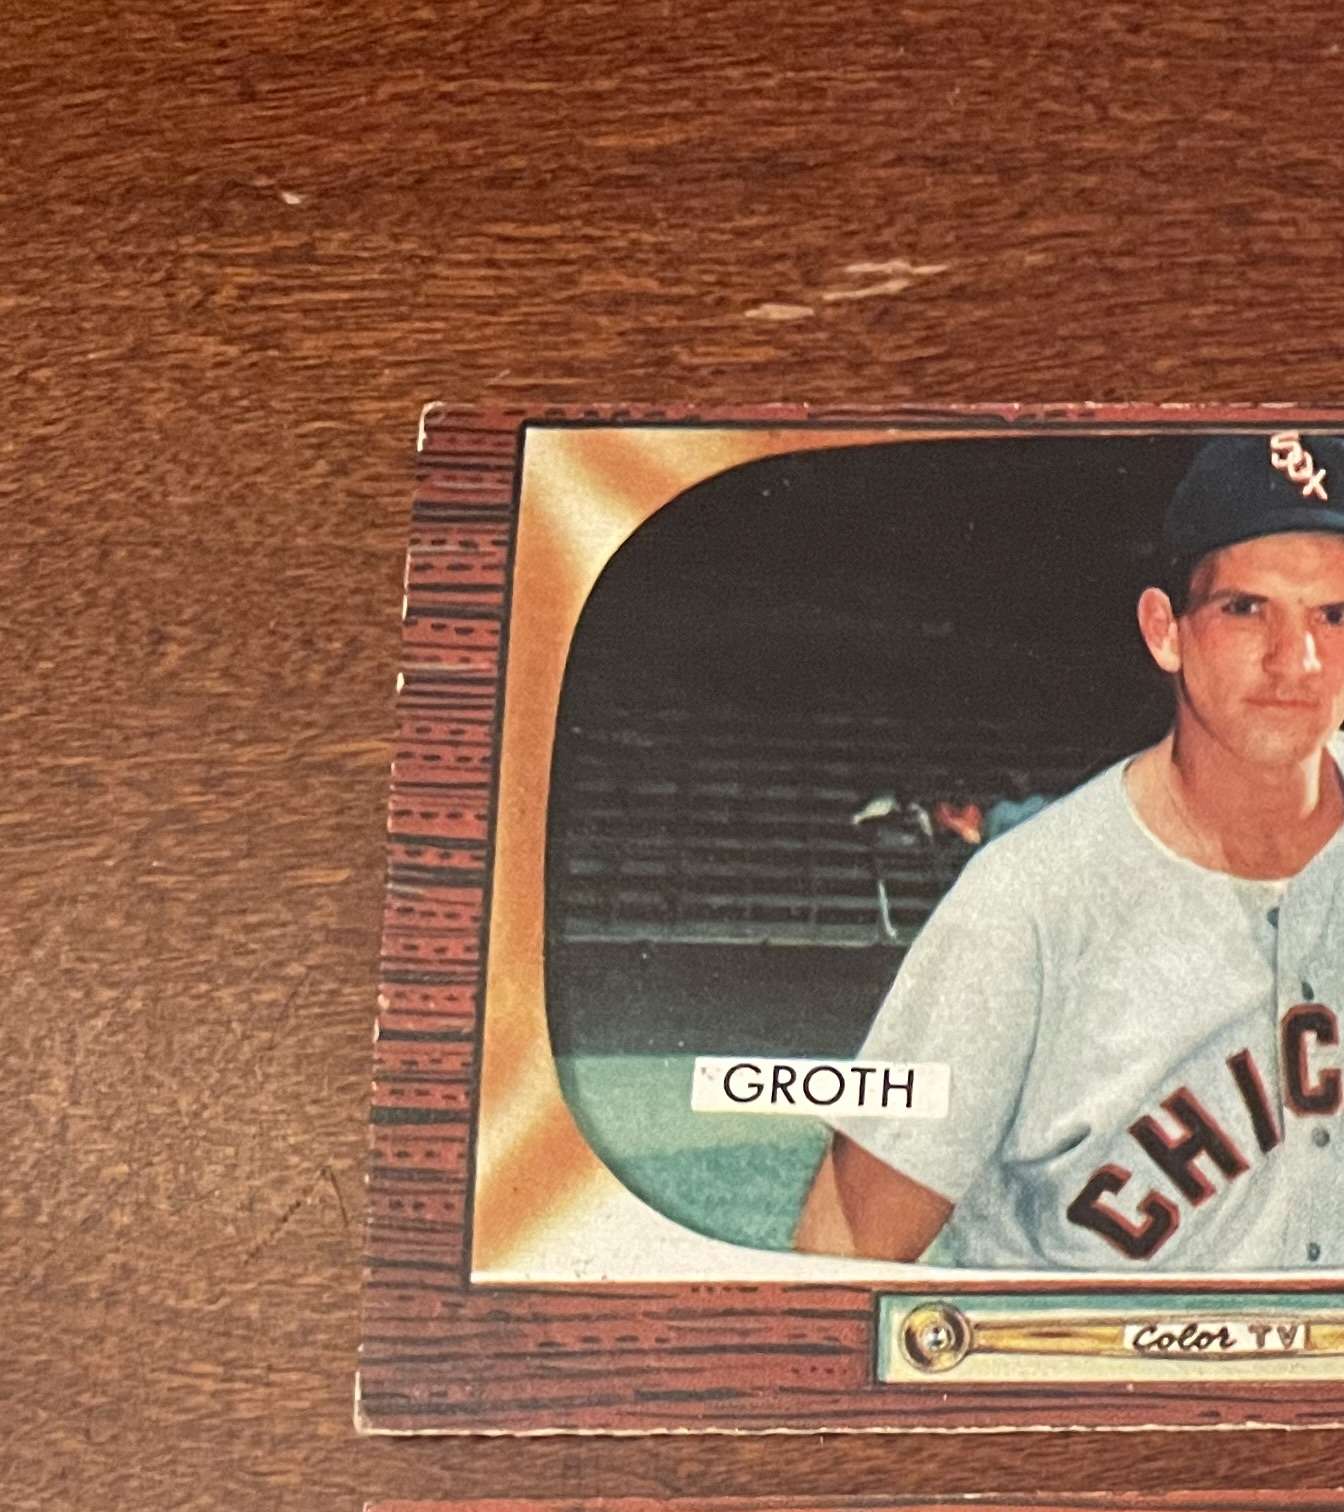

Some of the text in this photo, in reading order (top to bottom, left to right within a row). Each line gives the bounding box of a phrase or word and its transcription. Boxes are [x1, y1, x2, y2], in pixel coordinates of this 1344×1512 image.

[1270, 430, 1328, 501] SOX
[723, 1063, 914, 1108] GROTH
[1132, 1322, 1298, 1352] Color TV
